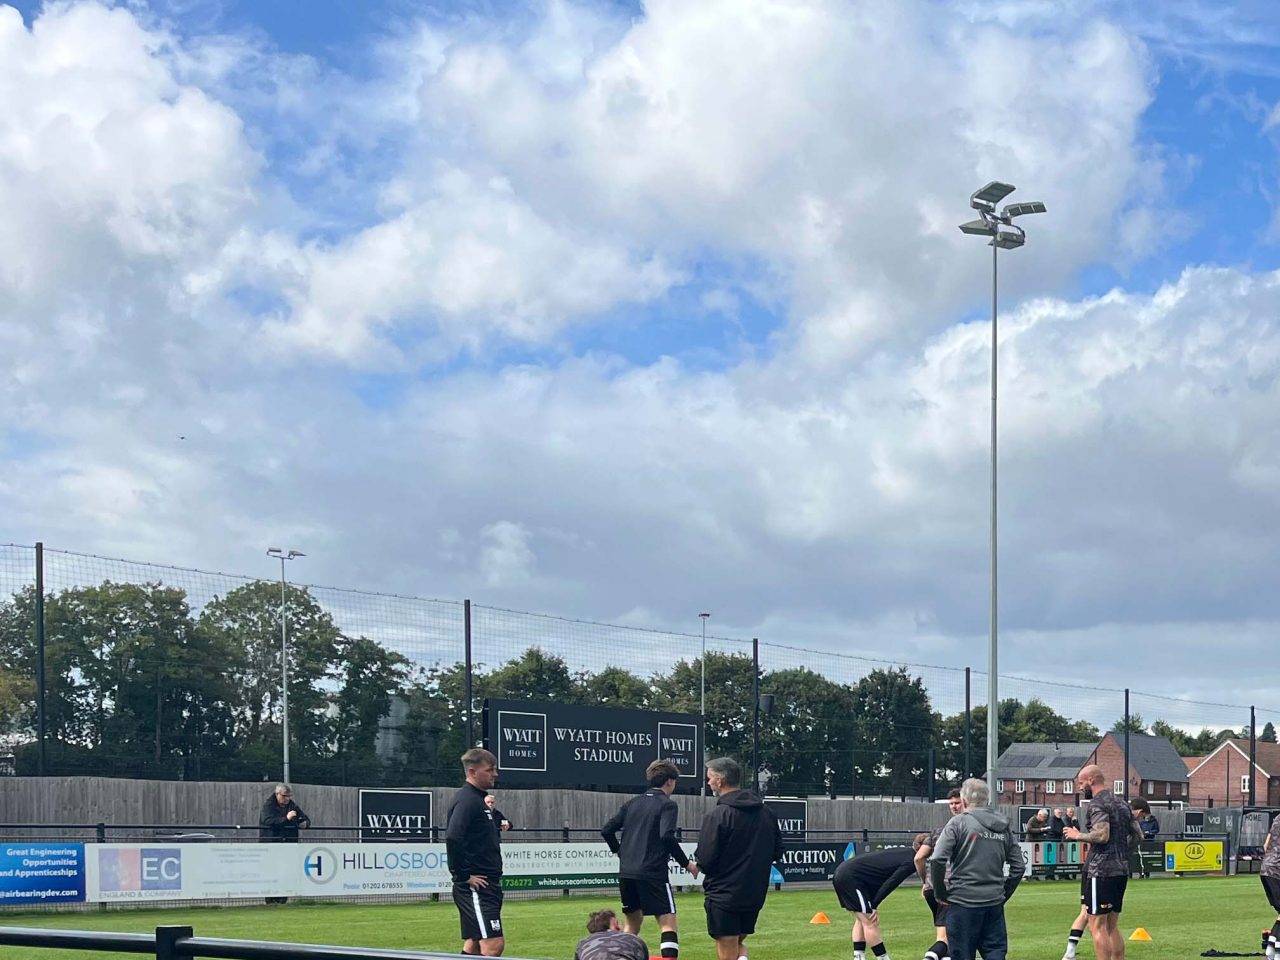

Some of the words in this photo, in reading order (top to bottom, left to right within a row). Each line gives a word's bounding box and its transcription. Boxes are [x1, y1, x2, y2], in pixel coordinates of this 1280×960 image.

[503, 728, 542, 743] WYATT
[554, 728, 602, 743] WYATT
[606, 731, 653, 746] HOMES
[663, 738, 694, 752] WYATT
[509, 749, 537, 758] HOMES
[574, 748, 634, 763] STADIUM
[1245, 814, 1262, 822] HOME
[367, 814, 426, 834] WYATT
[7, 848, 28, 856] Great
[30, 848, 77, 857] Engineering
[504, 850, 530, 859] WHITE
[535, 850, 562, 859] HORSE
[781, 850, 836, 863] ATCHTON
[22, 859, 77, 867] Opportunities
[504, 862, 560, 870] CONSTRUCTED
[15, 869, 77, 878] Apprenticeships
[142, 857, 180, 881] EC
[784, 867, 804, 875] plumbing
